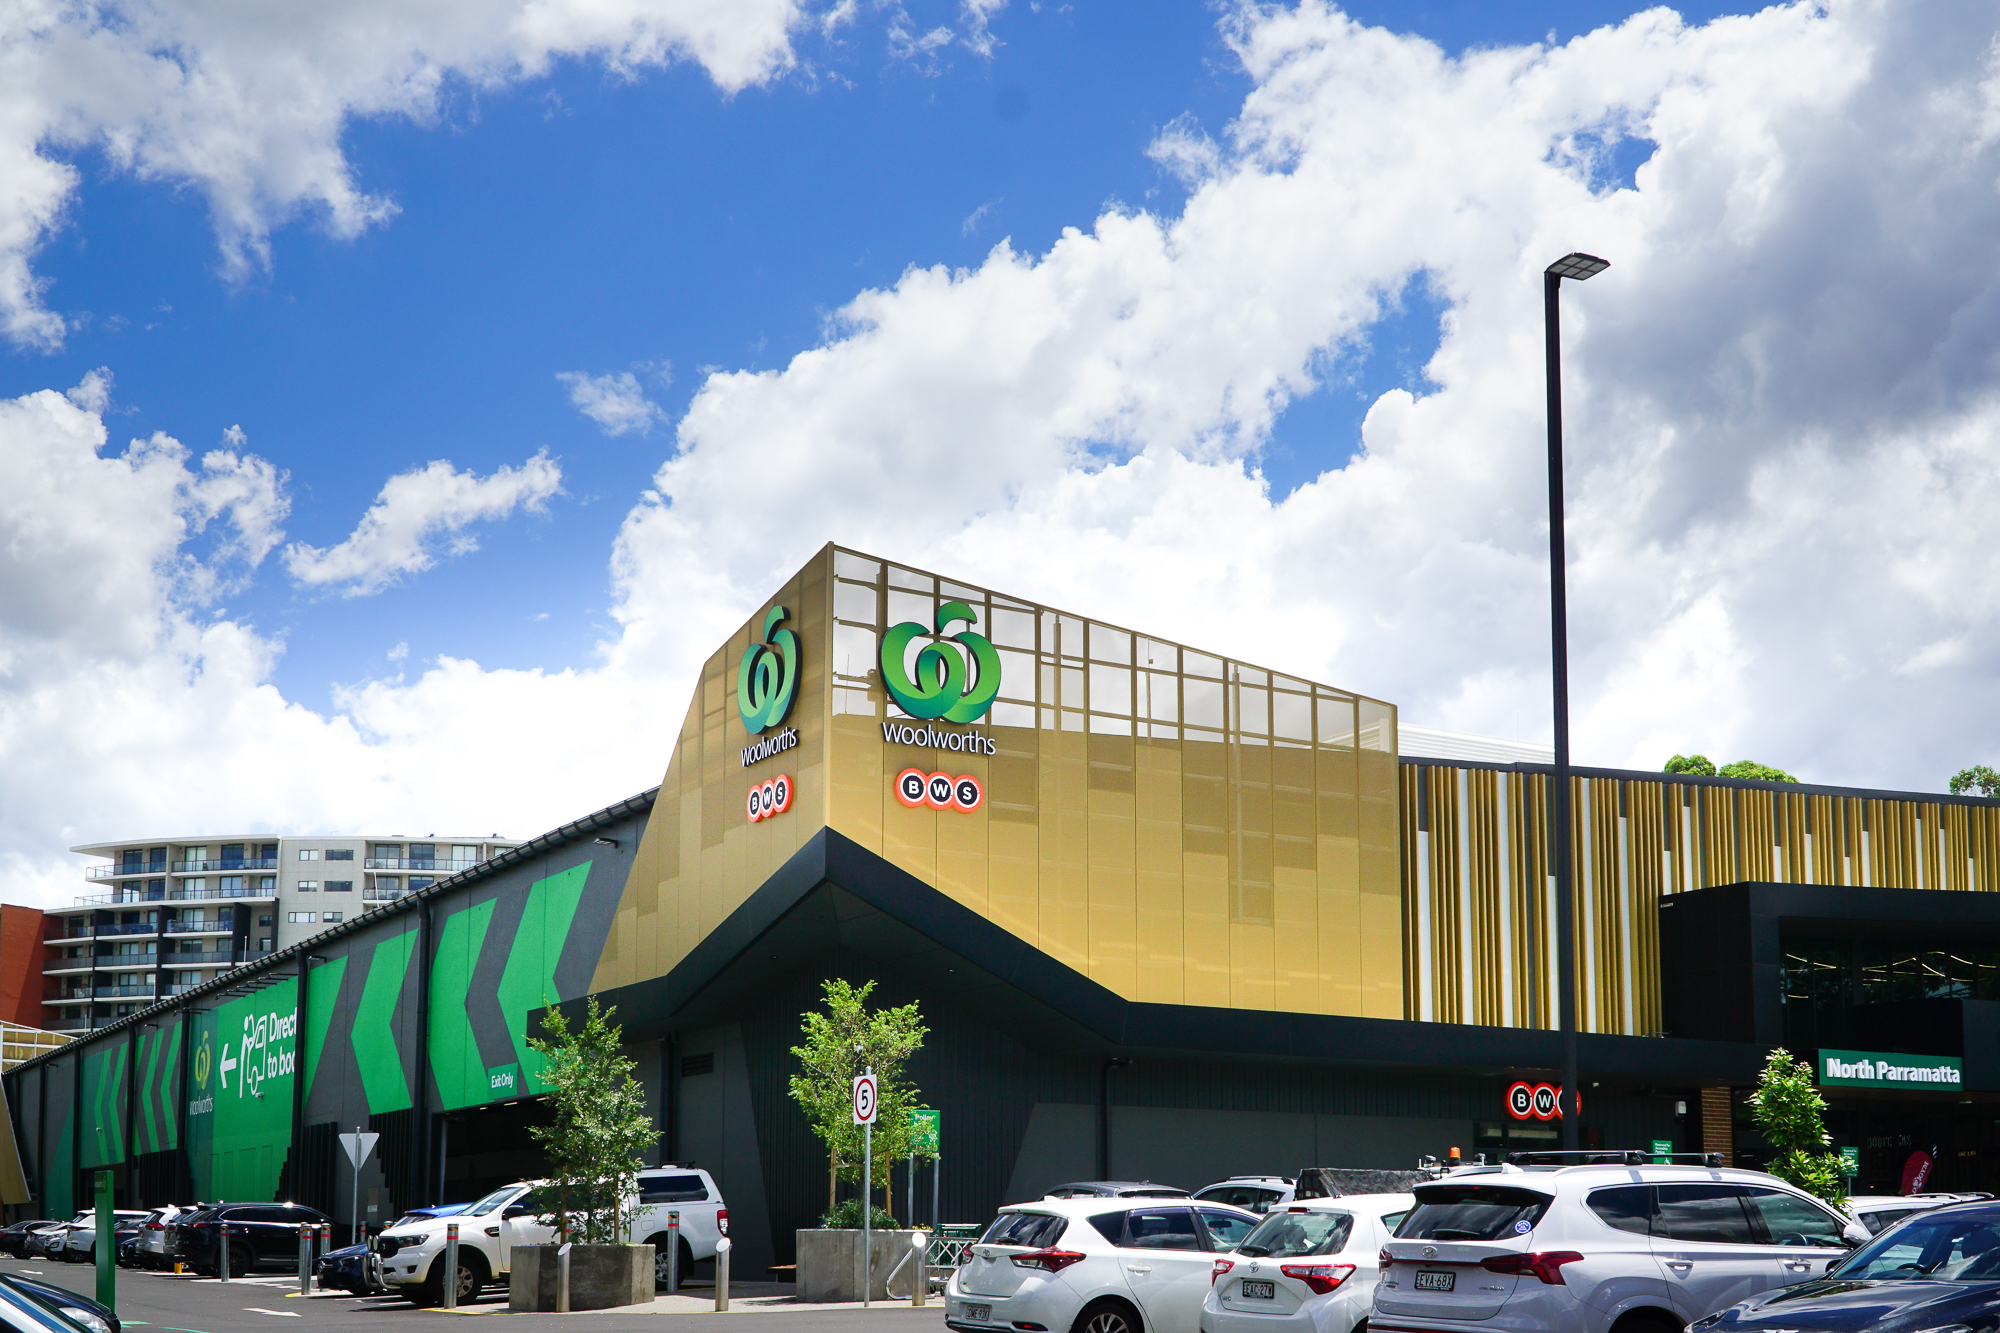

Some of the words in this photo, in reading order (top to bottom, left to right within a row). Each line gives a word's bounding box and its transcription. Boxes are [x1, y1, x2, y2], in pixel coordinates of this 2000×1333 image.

[740, 726, 797, 767] Woolworths
[881, 721, 996, 755] Woolworths
[267, 1052, 278, 1079] to
[1826, 1057, 1875, 1079] North
[1876, 1060, 1960, 1083] Parramatta
[491, 1074, 502, 1089] Exit
[501, 1072, 514, 1088] Only
[861, 1089, 869, 1110] 5
